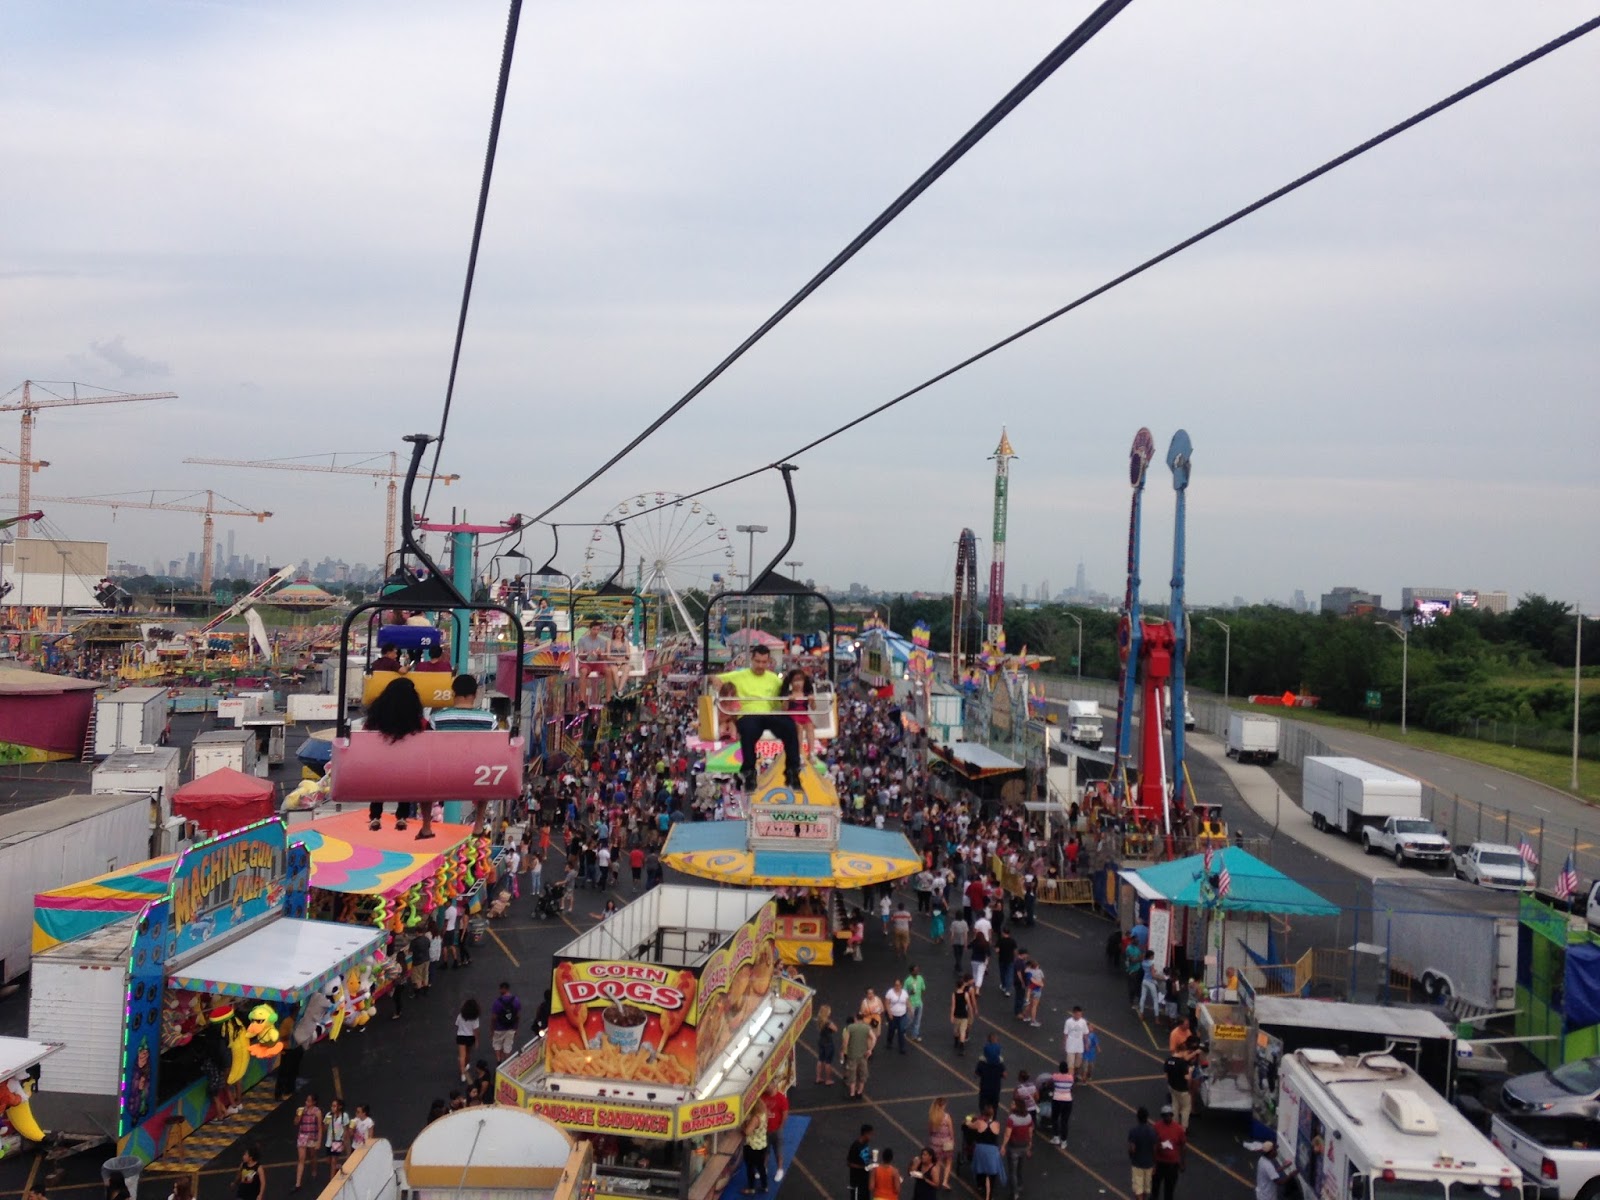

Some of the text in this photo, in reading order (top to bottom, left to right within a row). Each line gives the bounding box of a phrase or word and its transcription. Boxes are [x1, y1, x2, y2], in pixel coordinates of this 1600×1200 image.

[421, 637, 432, 646] 29
[433, 689, 451, 701] 28
[473, 765, 508, 786] 27
[174, 841, 273, 937] MACHINE GUN
[587, 964, 668, 984] CORN
[563, 979, 684, 1010] DOGS
[533, 1102, 669, 1135] SAUSAGE SANDWICH
[690, 1101, 728, 1120] COLD
[682, 1111, 736, 1135] DRINKS
